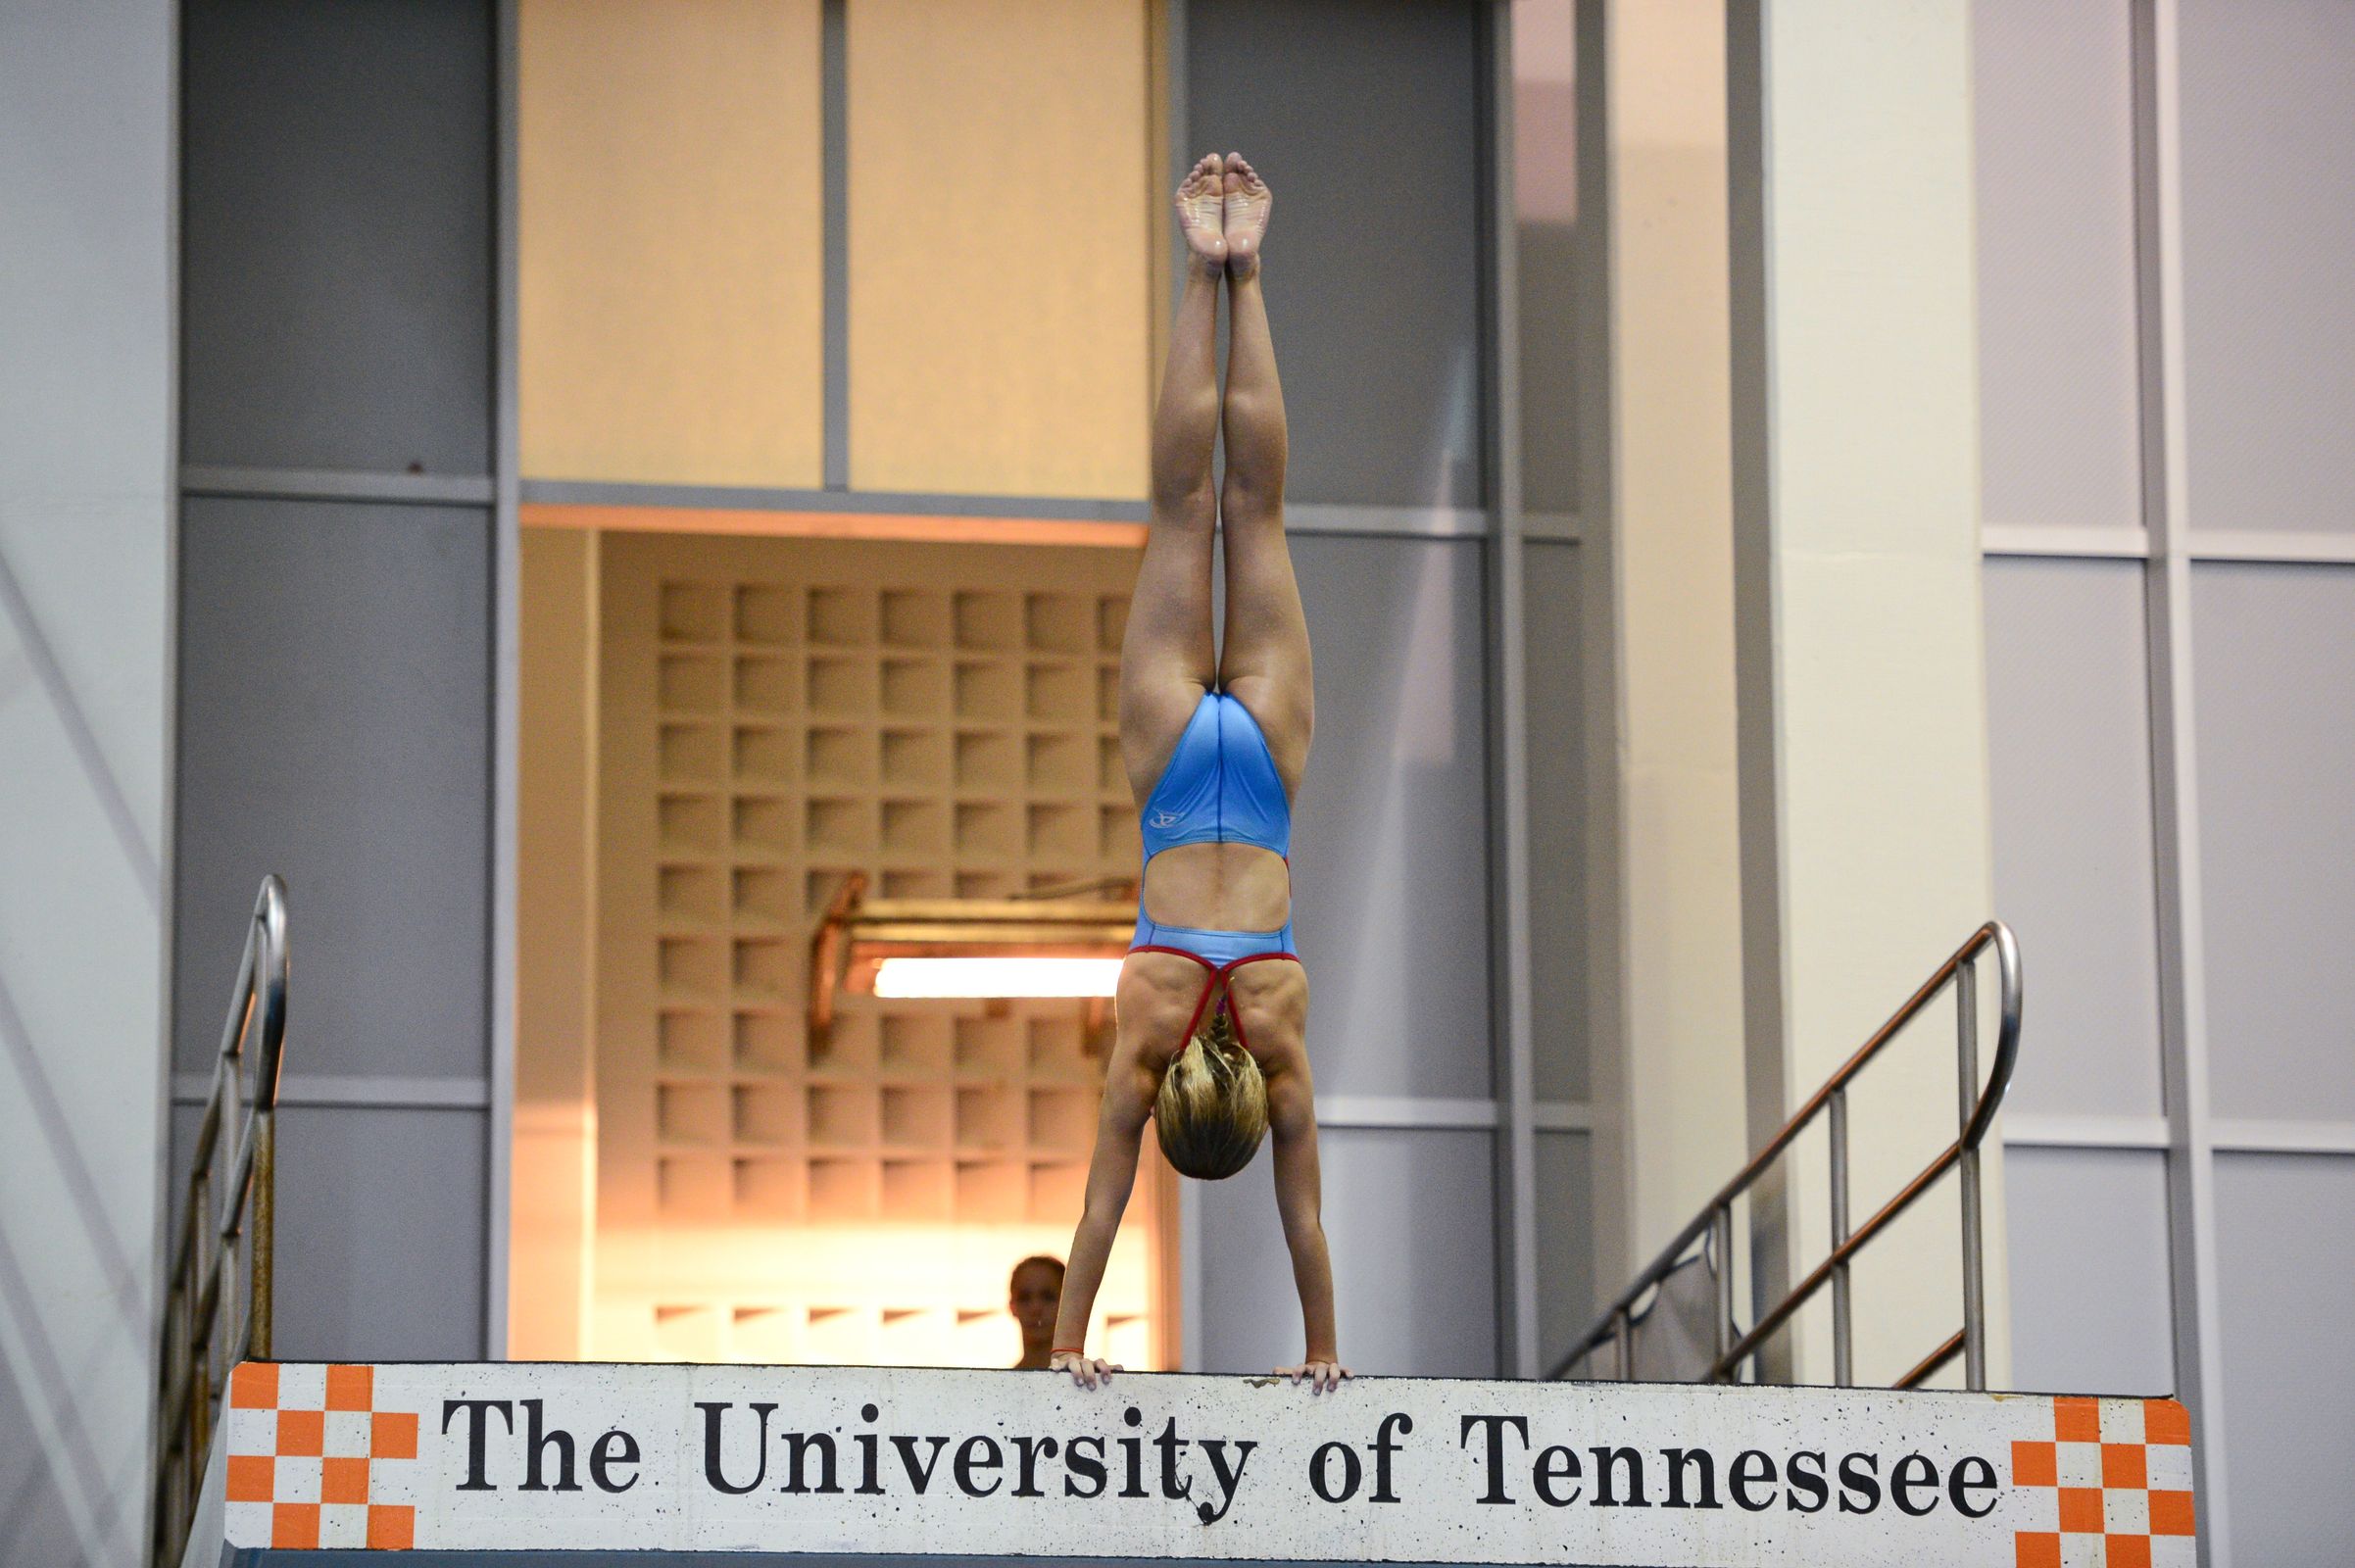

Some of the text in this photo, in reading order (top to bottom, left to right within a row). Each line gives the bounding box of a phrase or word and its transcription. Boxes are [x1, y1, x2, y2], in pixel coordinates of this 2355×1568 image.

[441, 1399, 1998, 1526] The University of Tennessee
